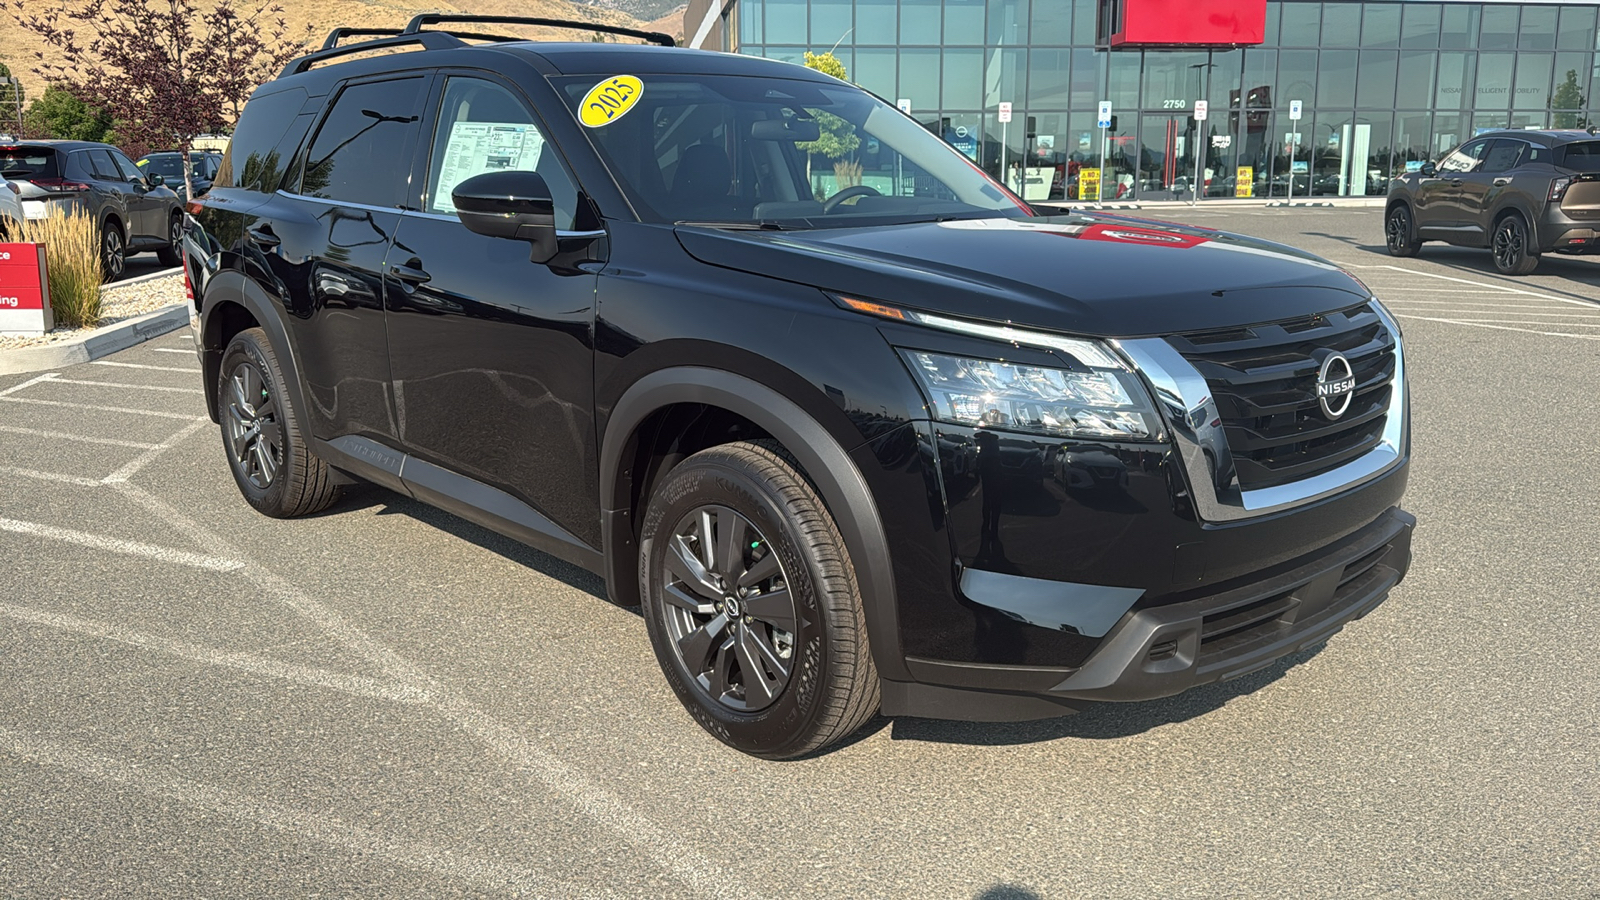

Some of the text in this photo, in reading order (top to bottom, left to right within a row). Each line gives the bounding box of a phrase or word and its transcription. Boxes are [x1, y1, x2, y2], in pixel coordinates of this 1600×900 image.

[590, 79, 634, 119] 2025
[1163, 99, 1186, 109] 2750
[1236, 178, 1251, 186] ARIFF
